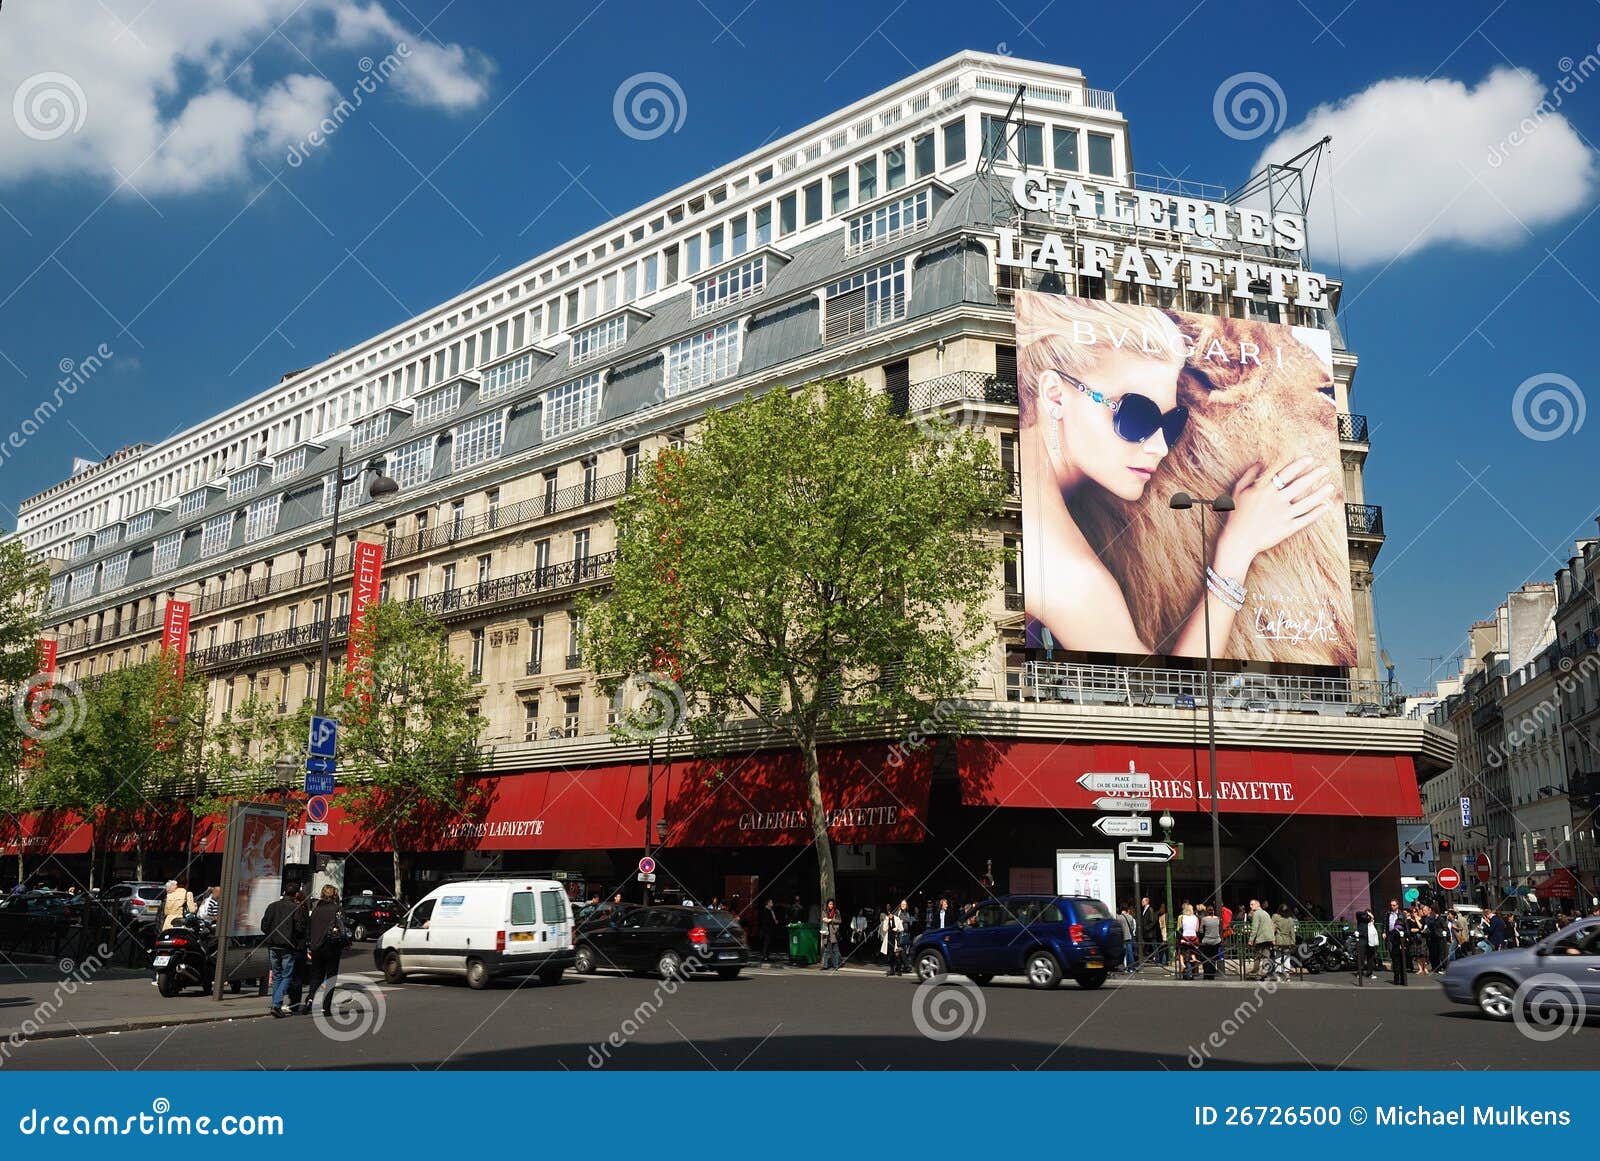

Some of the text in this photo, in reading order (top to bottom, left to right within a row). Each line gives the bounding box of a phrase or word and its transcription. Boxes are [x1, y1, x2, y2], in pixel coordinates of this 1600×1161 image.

[1011, 172, 1306, 251] GALERIES
[994, 227, 1328, 310] LAFAYETTE
[1072, 320, 1283, 370] BVLGARI
[489, 820, 545, 837] LAFAYETTE
[738, 805, 897, 831] GALERIES AFAYETTE
[1461, 797, 1470, 827] HOTEL
